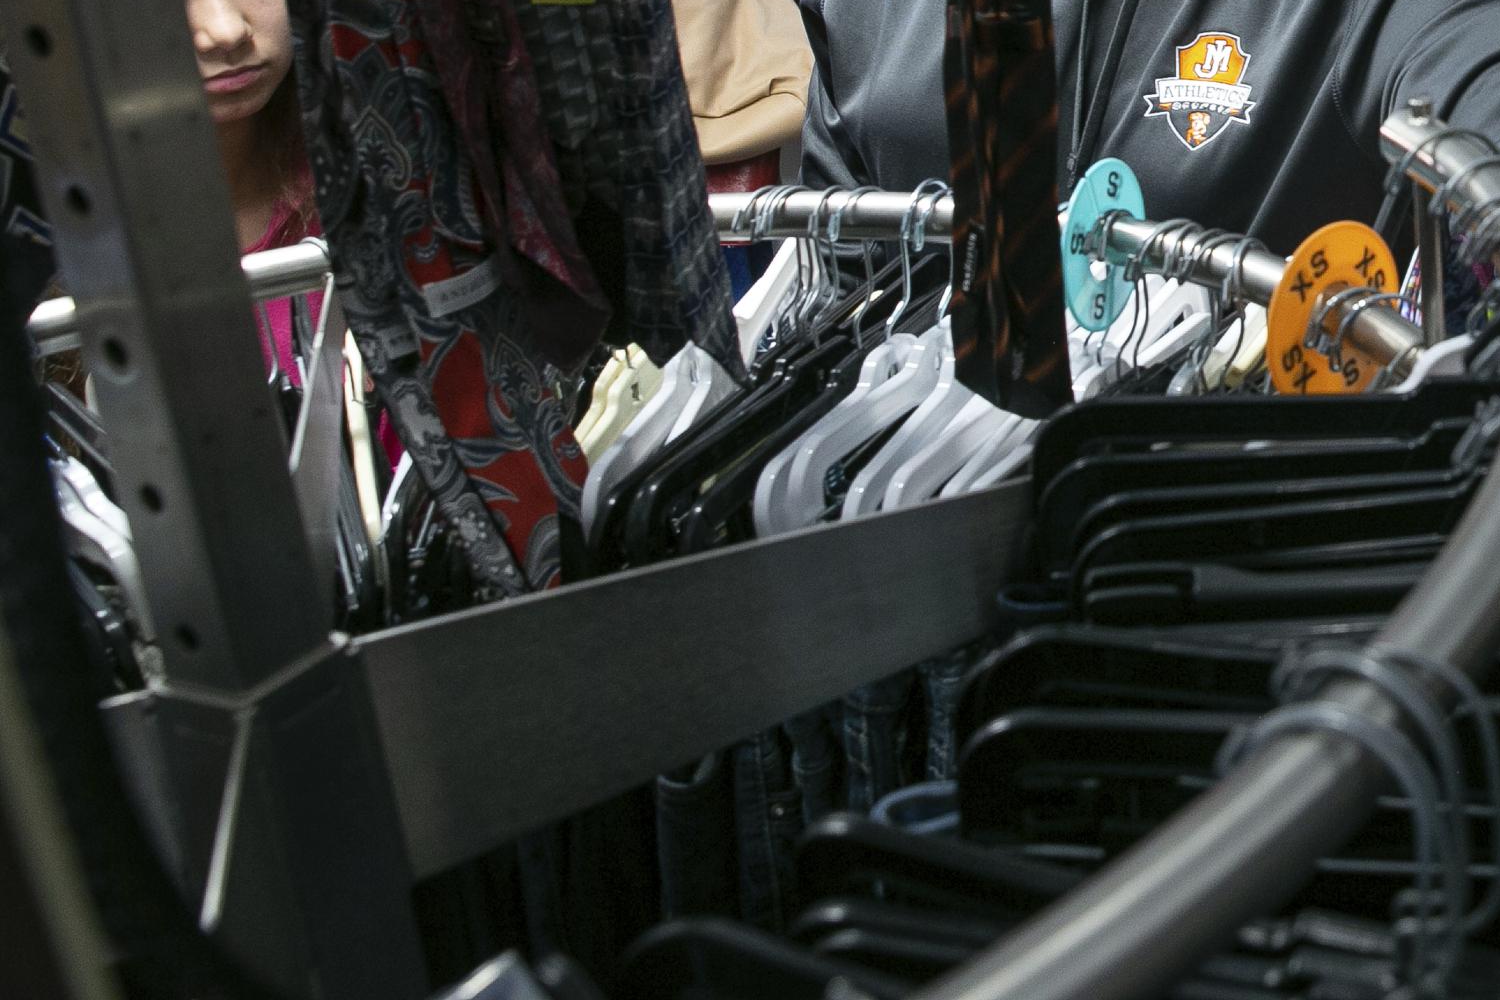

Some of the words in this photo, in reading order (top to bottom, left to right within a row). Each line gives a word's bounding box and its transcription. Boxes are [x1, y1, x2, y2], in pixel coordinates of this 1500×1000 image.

[1163, 84, 1247, 105] ATHLETICS
[1107, 171, 1120, 198] S
[1290, 250, 1330, 302] XS
[1355, 246, 1386, 290] XS
[1094, 293, 1107, 320] S
[1342, 357, 1360, 387] S
